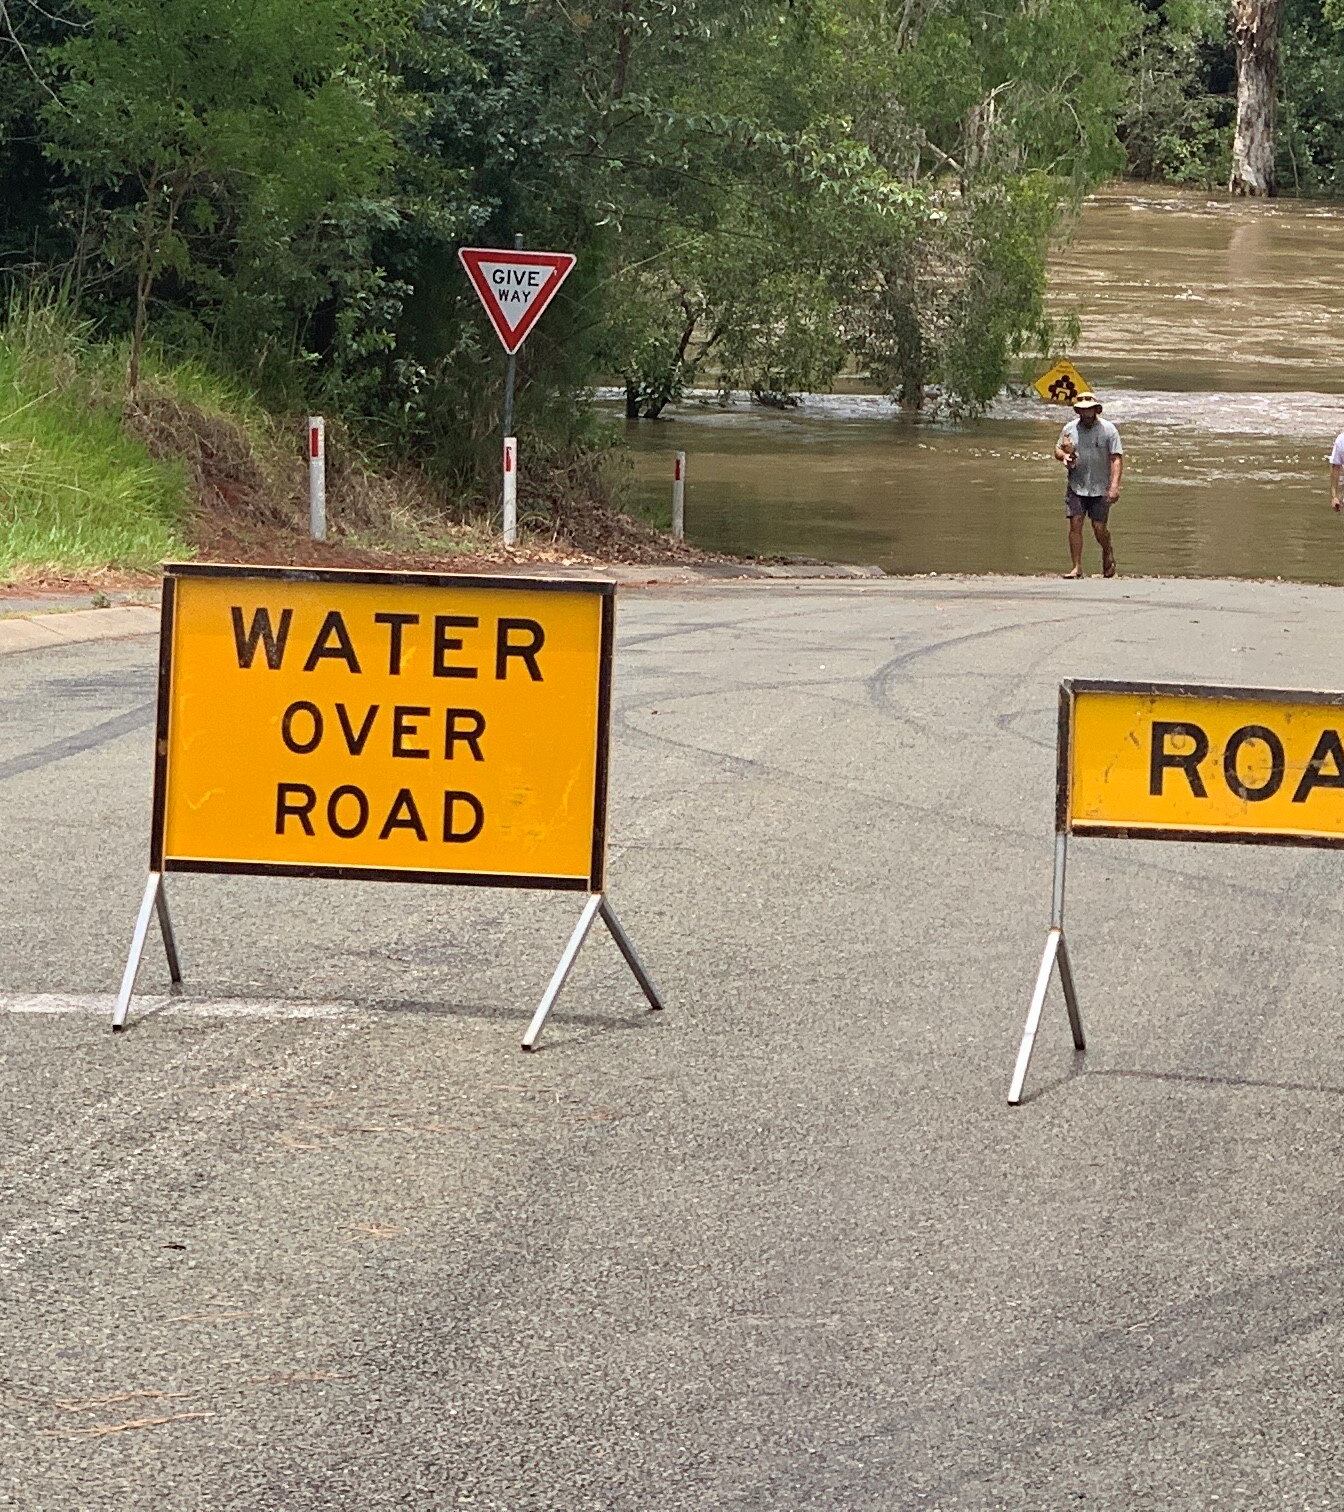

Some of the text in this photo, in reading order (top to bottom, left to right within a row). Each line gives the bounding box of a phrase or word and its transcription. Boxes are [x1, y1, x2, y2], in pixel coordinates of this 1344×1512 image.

[493, 269, 540, 286] GIVE
[498, 289, 531, 302] WAY
[231, 606, 545, 682] WATER
[281, 700, 486, 762] OVER
[275, 782, 484, 843] ROAD
